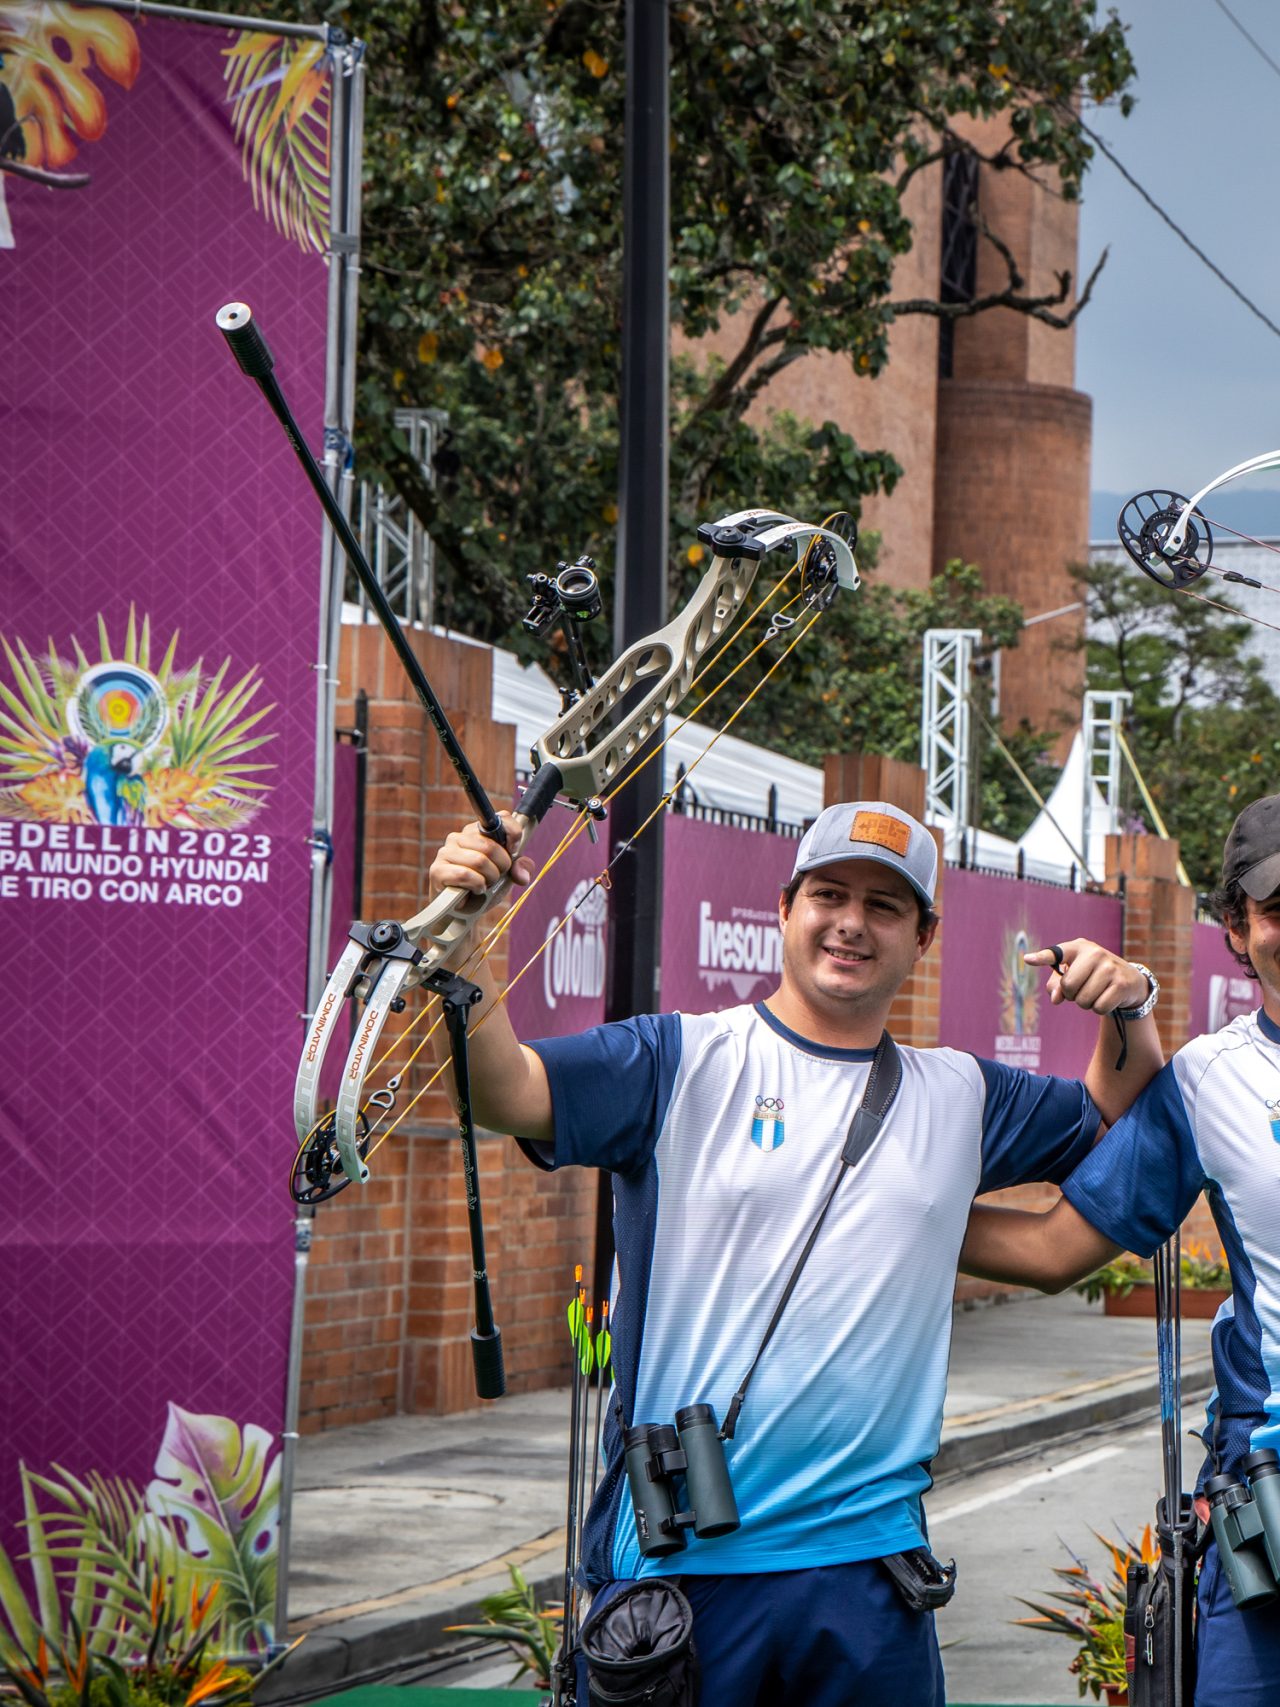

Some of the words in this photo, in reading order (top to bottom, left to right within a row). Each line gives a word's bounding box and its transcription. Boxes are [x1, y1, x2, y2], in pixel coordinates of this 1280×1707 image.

[178, 831, 271, 858] 2023
[41, 851, 143, 877] MUNDO
[150, 857, 269, 883] HYUNDAI
[26, 876, 93, 901] TIRO
[99, 879, 159, 904] CON
[164, 882, 243, 907] ARCO
[306, 993, 337, 1063] DOMINATOR
[349, 1010, 379, 1080] DOMINATOR
